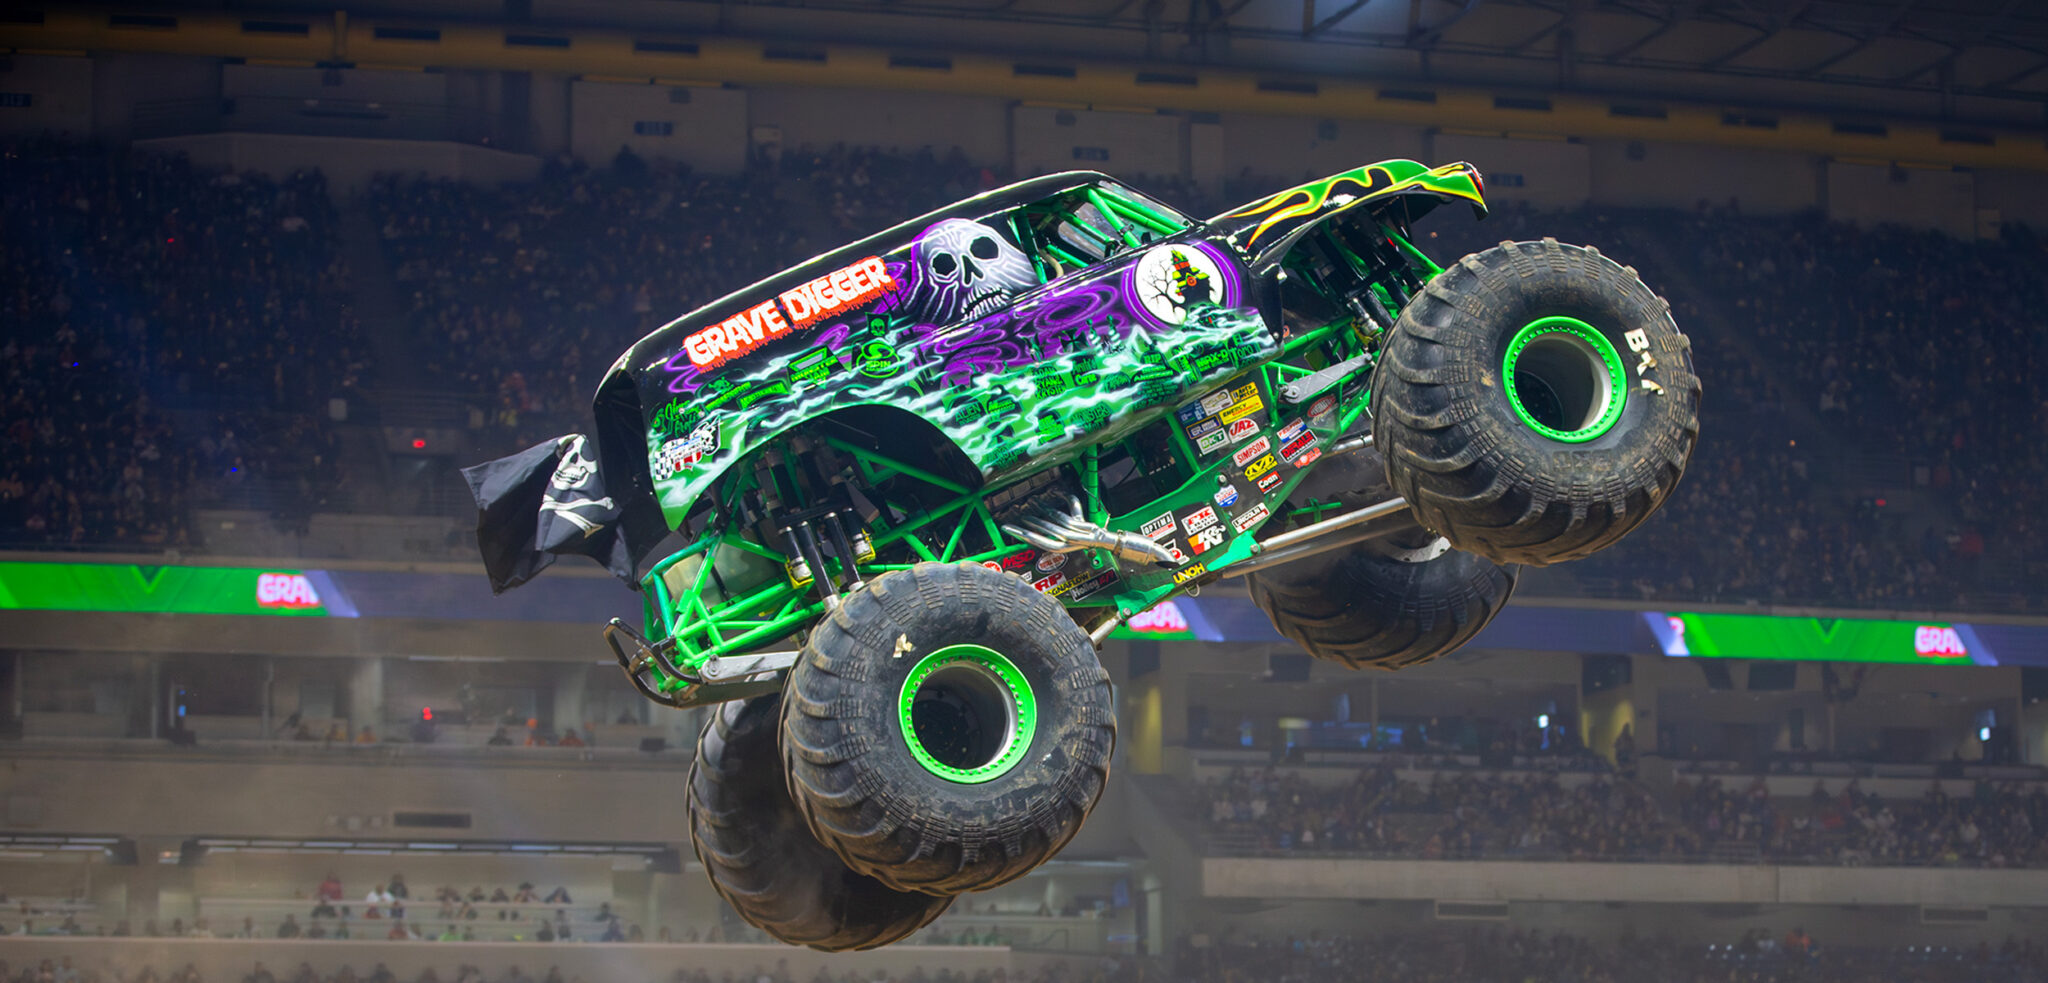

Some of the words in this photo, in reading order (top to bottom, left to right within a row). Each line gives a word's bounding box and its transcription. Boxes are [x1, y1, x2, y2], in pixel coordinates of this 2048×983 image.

[684, 300, 790, 368] GRAVE
[780, 256, 894, 324] DIGGER
[955, 402, 981, 422] ALIEN
[1230, 420, 1255, 436] JAZ
[1201, 430, 1225, 449] BKT
[1282, 431, 1314, 458] DERALE
[1236, 440, 1267, 463] SIMPSON
[1258, 474, 1279, 488] Coan
[1143, 515, 1172, 534] OPTIMA
[1198, 525, 1226, 551] K&N
[1002, 549, 1036, 569] MSD
[1173, 562, 1206, 583] UNOH
[1046, 572, 1089, 596] AGNAFLOW
[1071, 579, 1101, 599] Holley
